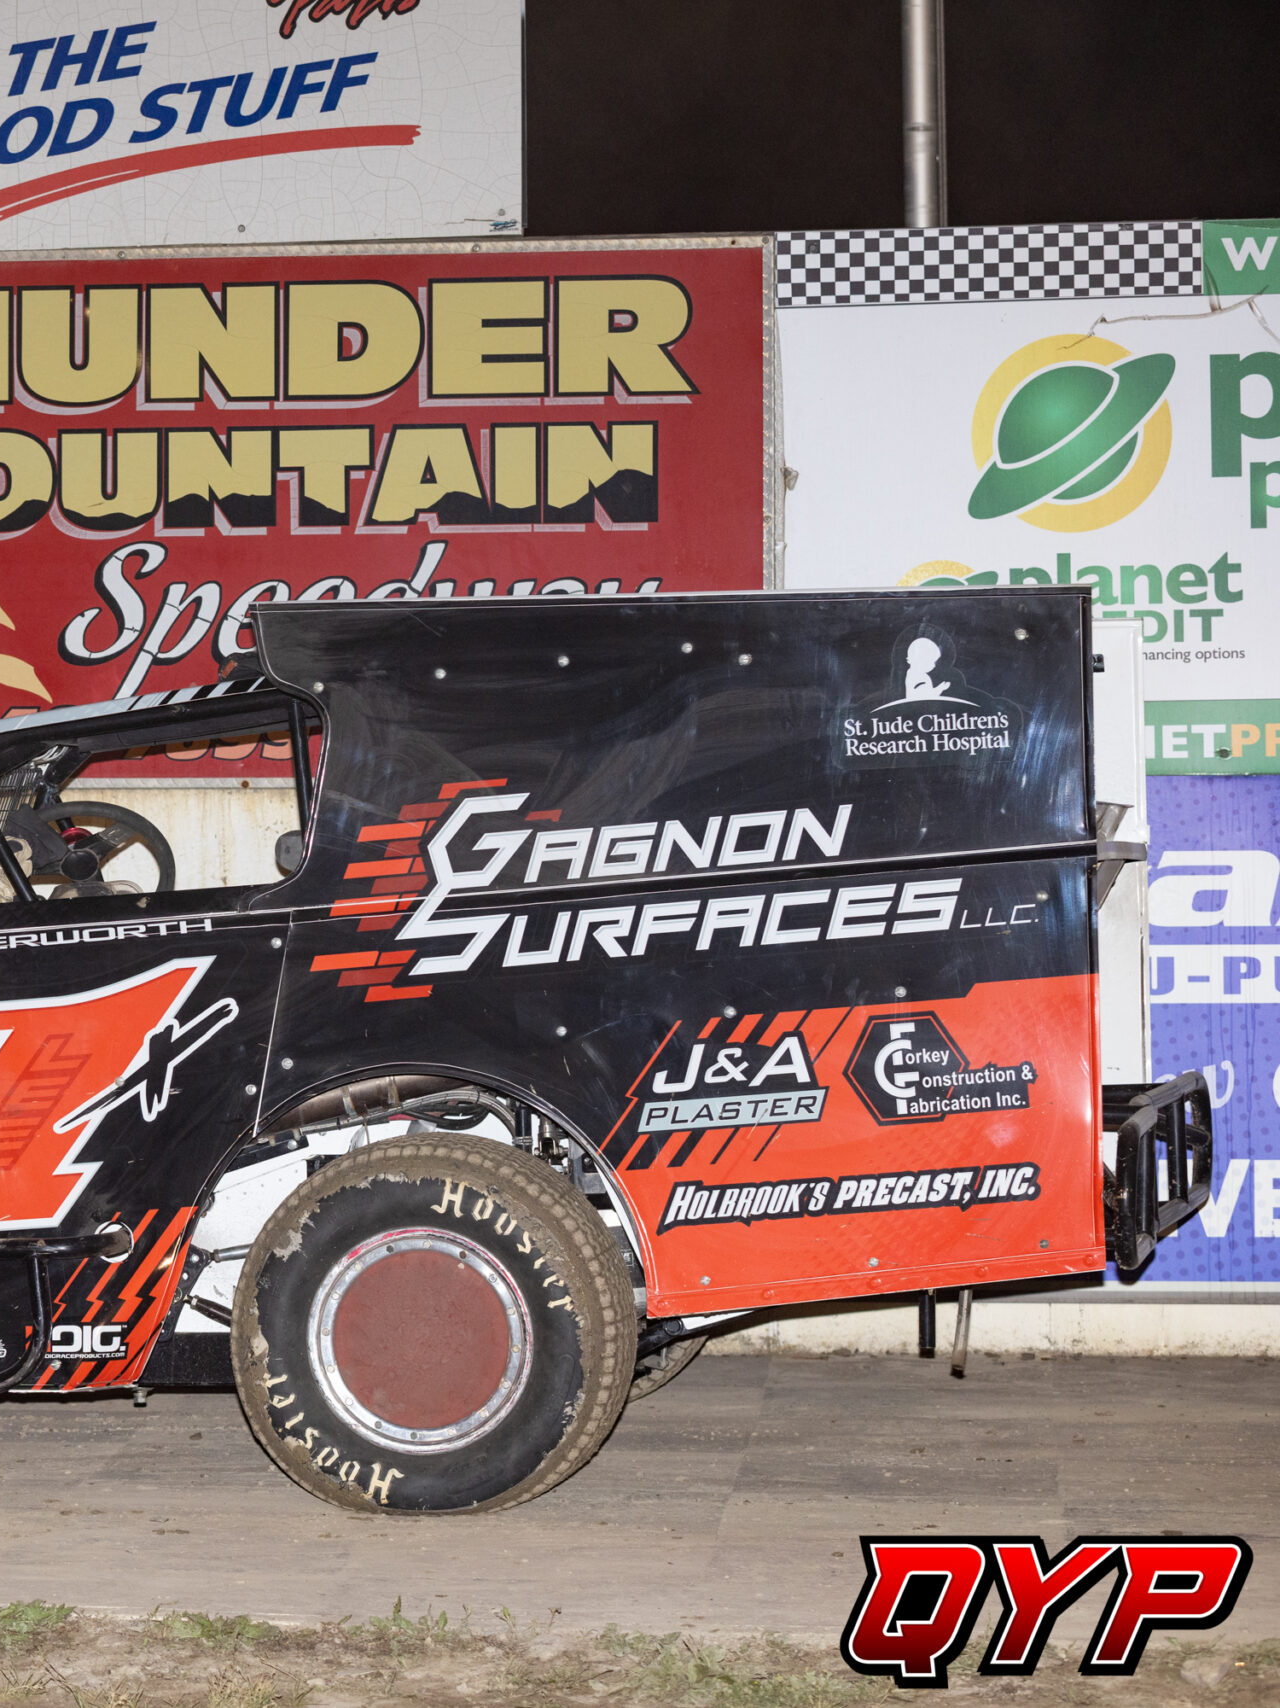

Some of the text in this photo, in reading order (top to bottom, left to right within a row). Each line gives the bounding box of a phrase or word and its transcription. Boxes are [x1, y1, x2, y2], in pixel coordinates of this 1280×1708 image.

[7, 22, 154, 96] THE
[129, 52, 378, 144] STUFF
[1195, 649, 1246, 663] options
[844, 712, 1009, 738] St. Jude Children's
[846, 731, 1011, 756] Research Hospital
[424, 793, 854, 895] GAGNON
[395, 878, 964, 976] SURFACES
[652, 1036, 812, 1094] J&A
[1020, 1069, 1035, 1082] &
[645, 1095, 819, 1127] PLASTER
[996, 1091, 1027, 1107] Inc.
[663, 1165, 1038, 1226] HOLBROOK'S PRECAST, INC.
